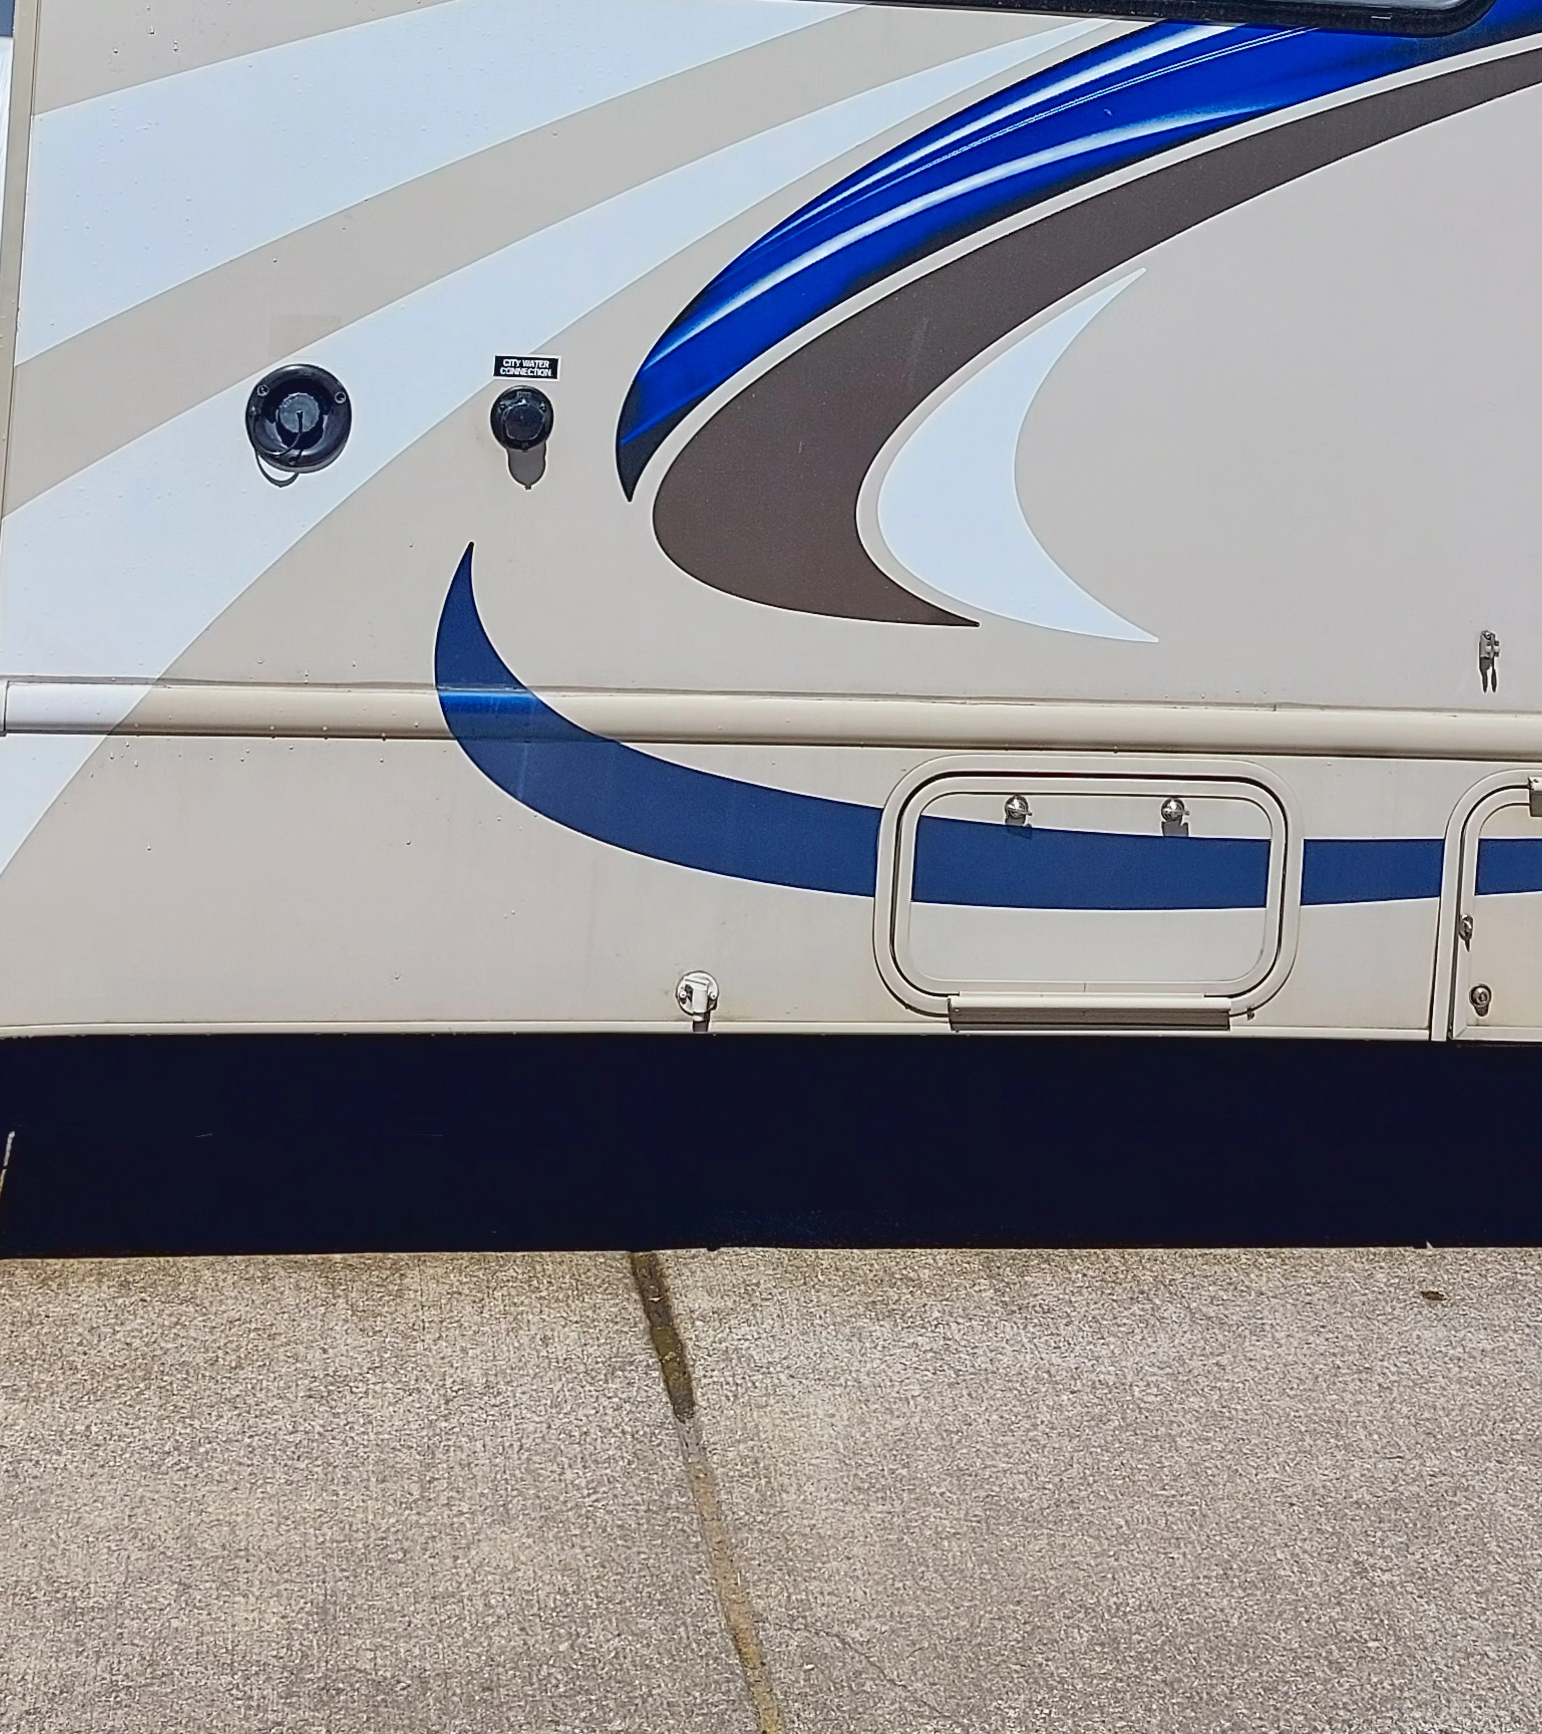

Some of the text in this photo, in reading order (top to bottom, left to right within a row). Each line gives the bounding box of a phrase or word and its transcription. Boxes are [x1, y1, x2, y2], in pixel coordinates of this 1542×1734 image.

[502, 358, 550, 368] CITY WATER
[499, 367, 552, 377] CONNECTION
